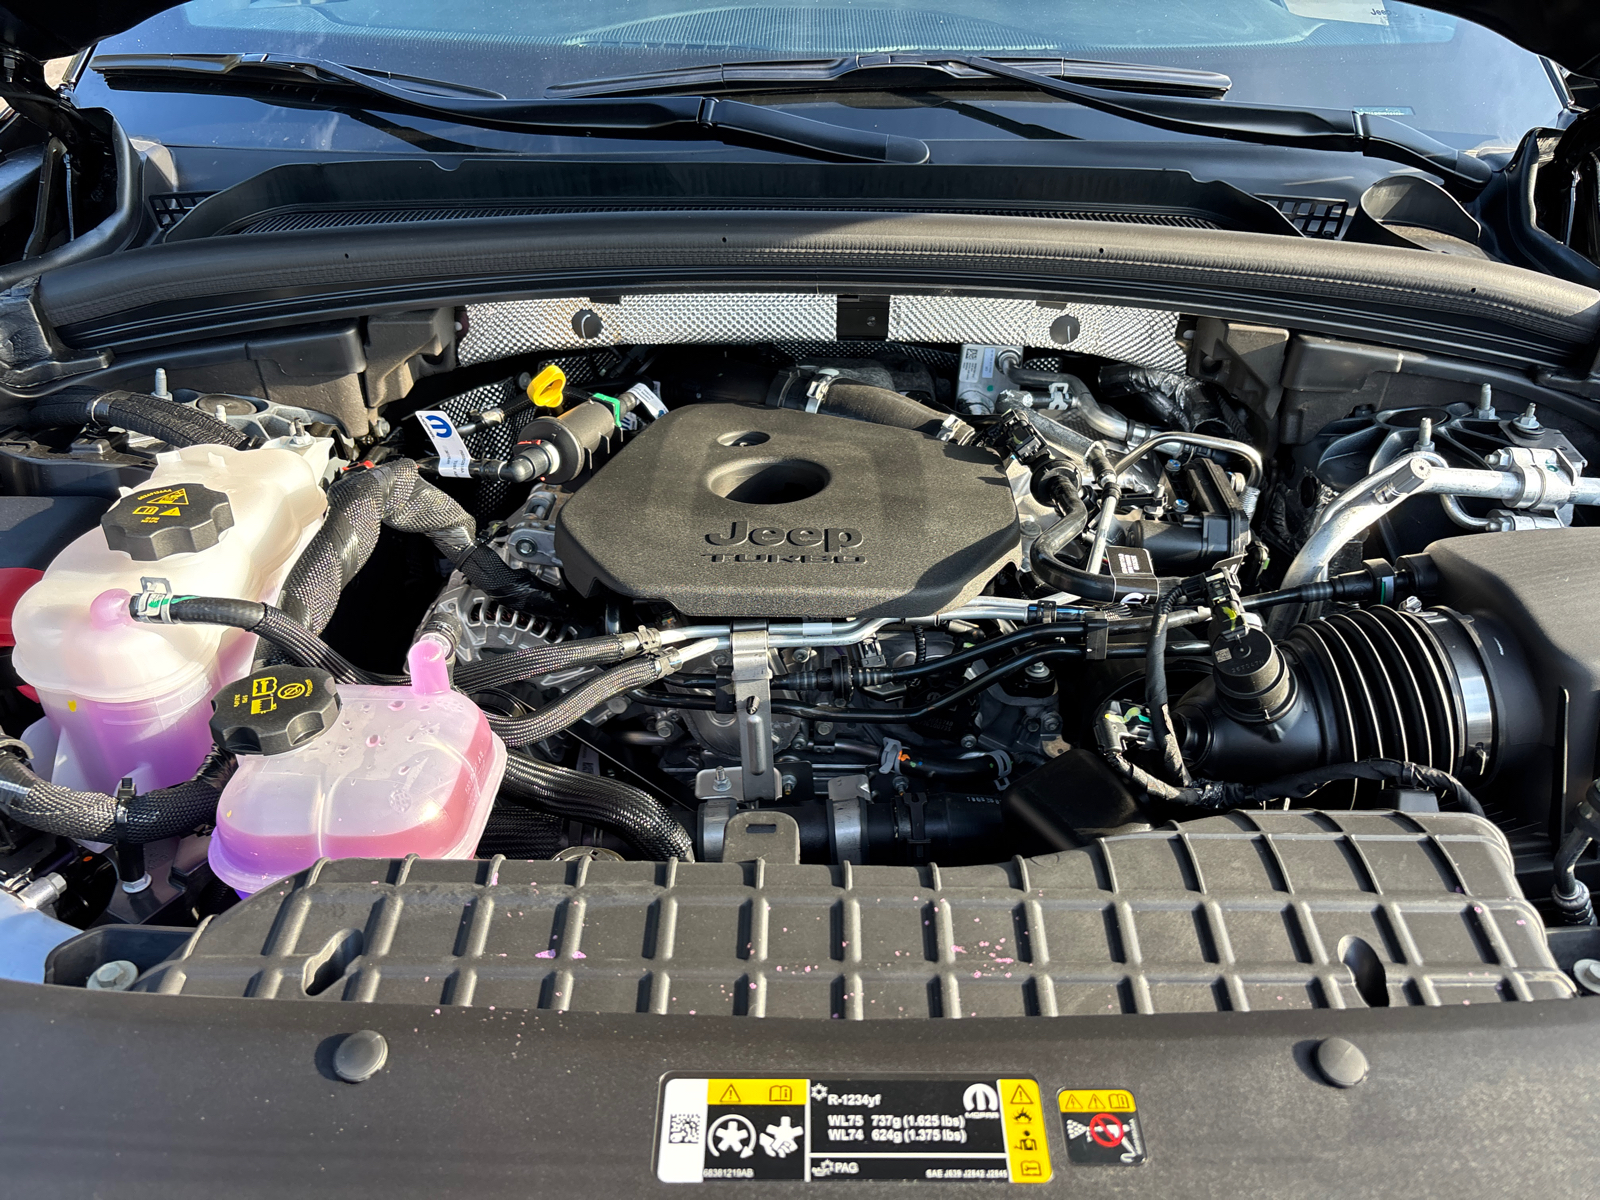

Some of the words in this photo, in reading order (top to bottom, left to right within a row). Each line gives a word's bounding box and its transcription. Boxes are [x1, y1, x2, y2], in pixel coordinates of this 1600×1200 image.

[704, 521, 864, 553] Jeep
[701, 553, 868, 564] TURBO
[827, 1093, 882, 1108] R-1234yf
[827, 1114, 864, 1127] WL75
[871, 1114, 902, 1129] 737g
[903, 1114, 940, 1129] (1.625
[941, 1114, 966, 1129] lbs)
[827, 1128, 865, 1142] WL74
[871, 1129, 903, 1143] 624g
[903, 1129, 941, 1143] (1.375
[942, 1129, 967, 1143] lbs)
[834, 1161, 860, 1174] PAG
[925, 1168, 943, 1179] SAE
